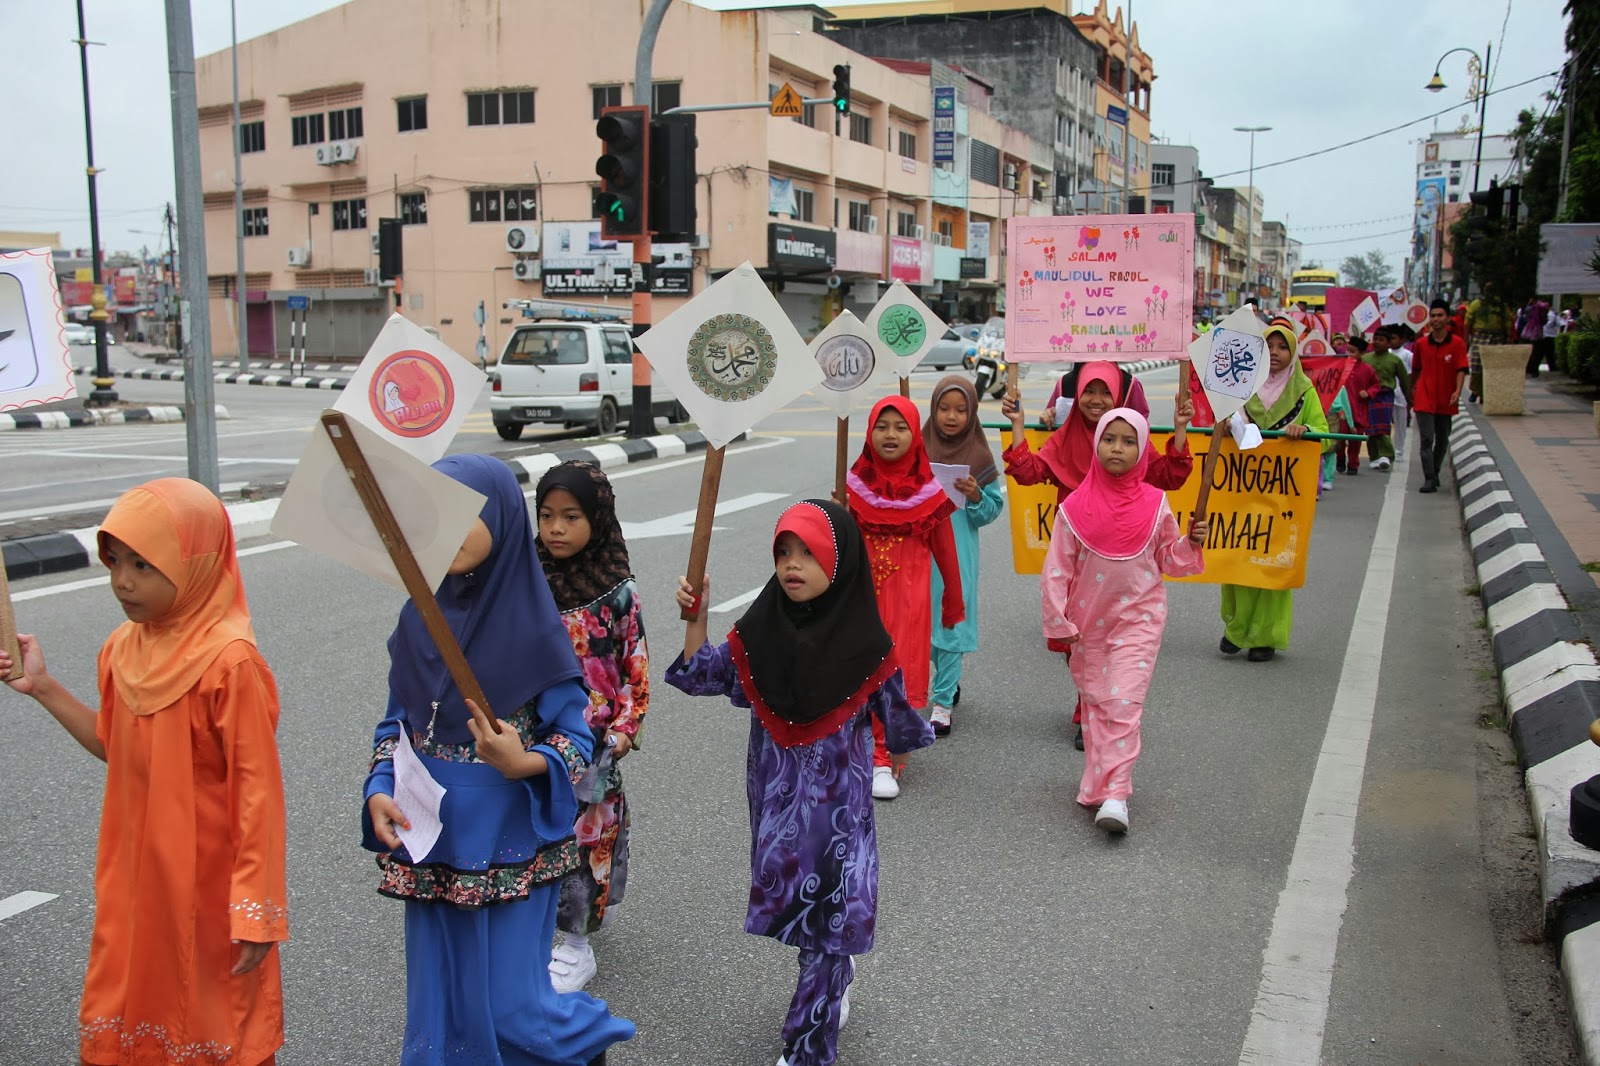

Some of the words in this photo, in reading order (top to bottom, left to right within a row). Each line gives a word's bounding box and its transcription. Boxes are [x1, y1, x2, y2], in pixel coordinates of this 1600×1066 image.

[1068, 251, 1117, 262] SALAM
[1034, 270, 1103, 282] MAULIDUL
[1109, 271, 1149, 282] RASUL
[1085, 287, 1115, 298] WE
[1085, 306, 1127, 317] LOVE
[1071, 323, 1147, 336] RASULALLAH
[1194, 452, 1300, 496] TONGGAK
